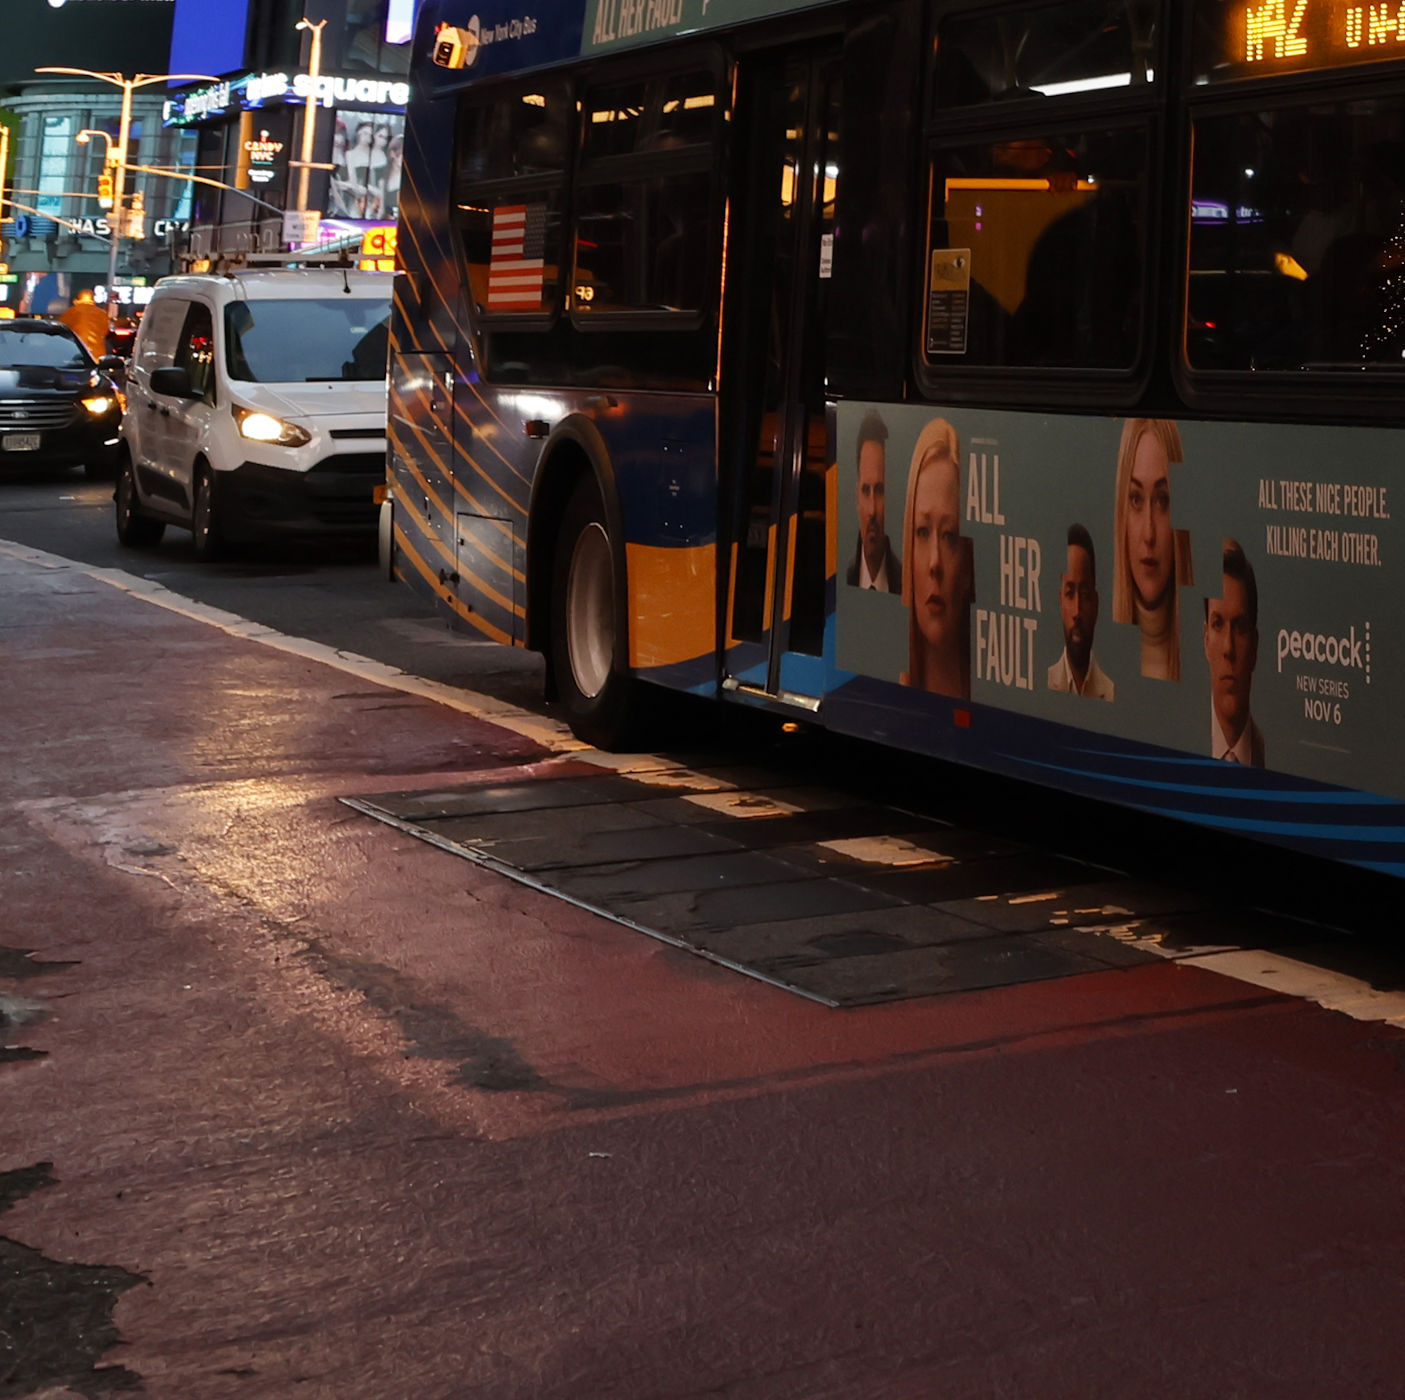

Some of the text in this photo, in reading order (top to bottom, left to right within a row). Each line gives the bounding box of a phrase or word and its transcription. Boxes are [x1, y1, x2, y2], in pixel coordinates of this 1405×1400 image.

[293, 74, 409, 108] square
[967, 453, 1005, 525] ALL
[1258, 478, 1390, 519] ALL THESE NICE PEOPLE.
[1266, 525, 1382, 566] KILLING EACH OTHER.
[1000, 535, 1041, 612] HER
[976, 610, 1038, 691] FAULT
[1277, 624, 1362, 673] peacock
[1296, 674, 1349, 699] NEW SERIES
[1305, 699, 1342, 724] NOV 6
